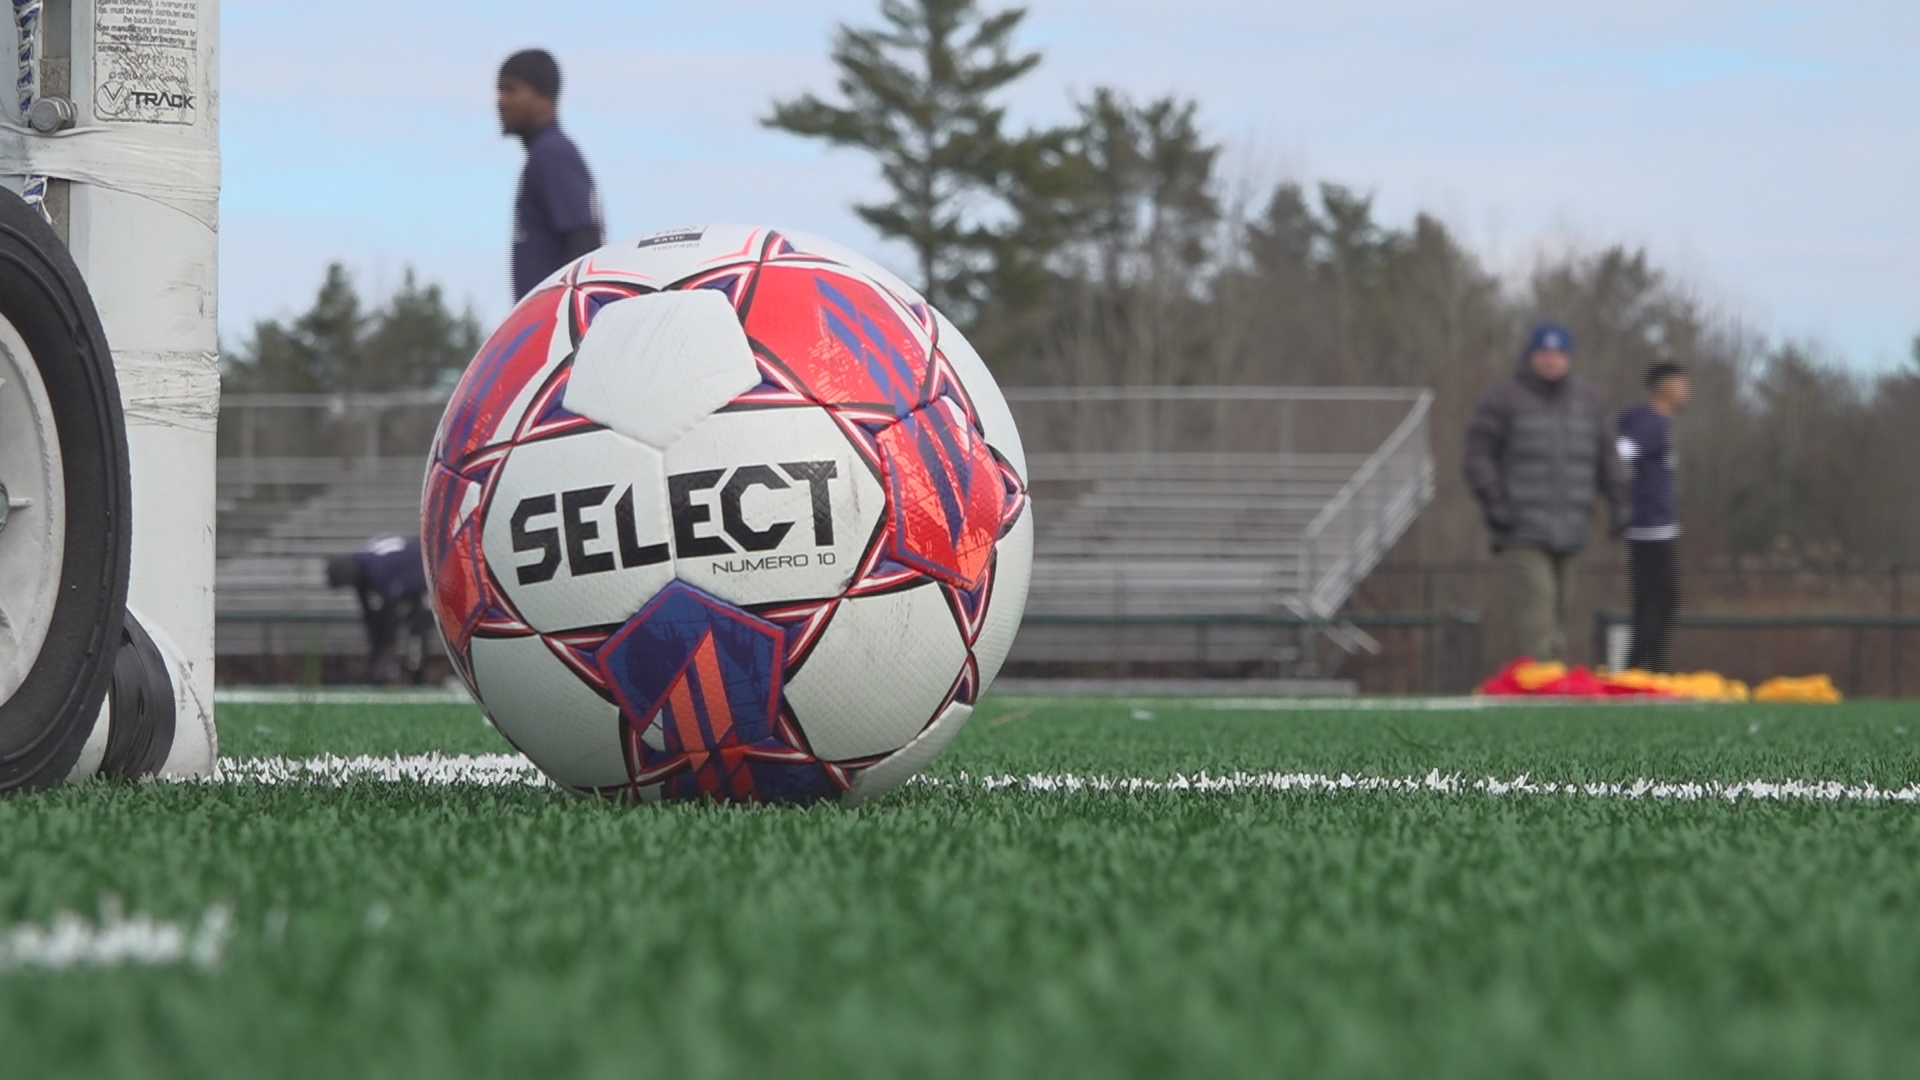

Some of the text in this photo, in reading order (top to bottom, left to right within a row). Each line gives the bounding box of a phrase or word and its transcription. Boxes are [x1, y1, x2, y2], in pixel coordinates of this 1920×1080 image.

[135, 8, 153, 16] evenly
[134, 16, 147, 24] back
[159, 27, 188, 36] instructions
[131, 92, 194, 109] TRACK
[654, 235, 685, 243] BASIC
[510, 460, 838, 586] SELECT
[712, 552, 836, 575] NUMERO 10
